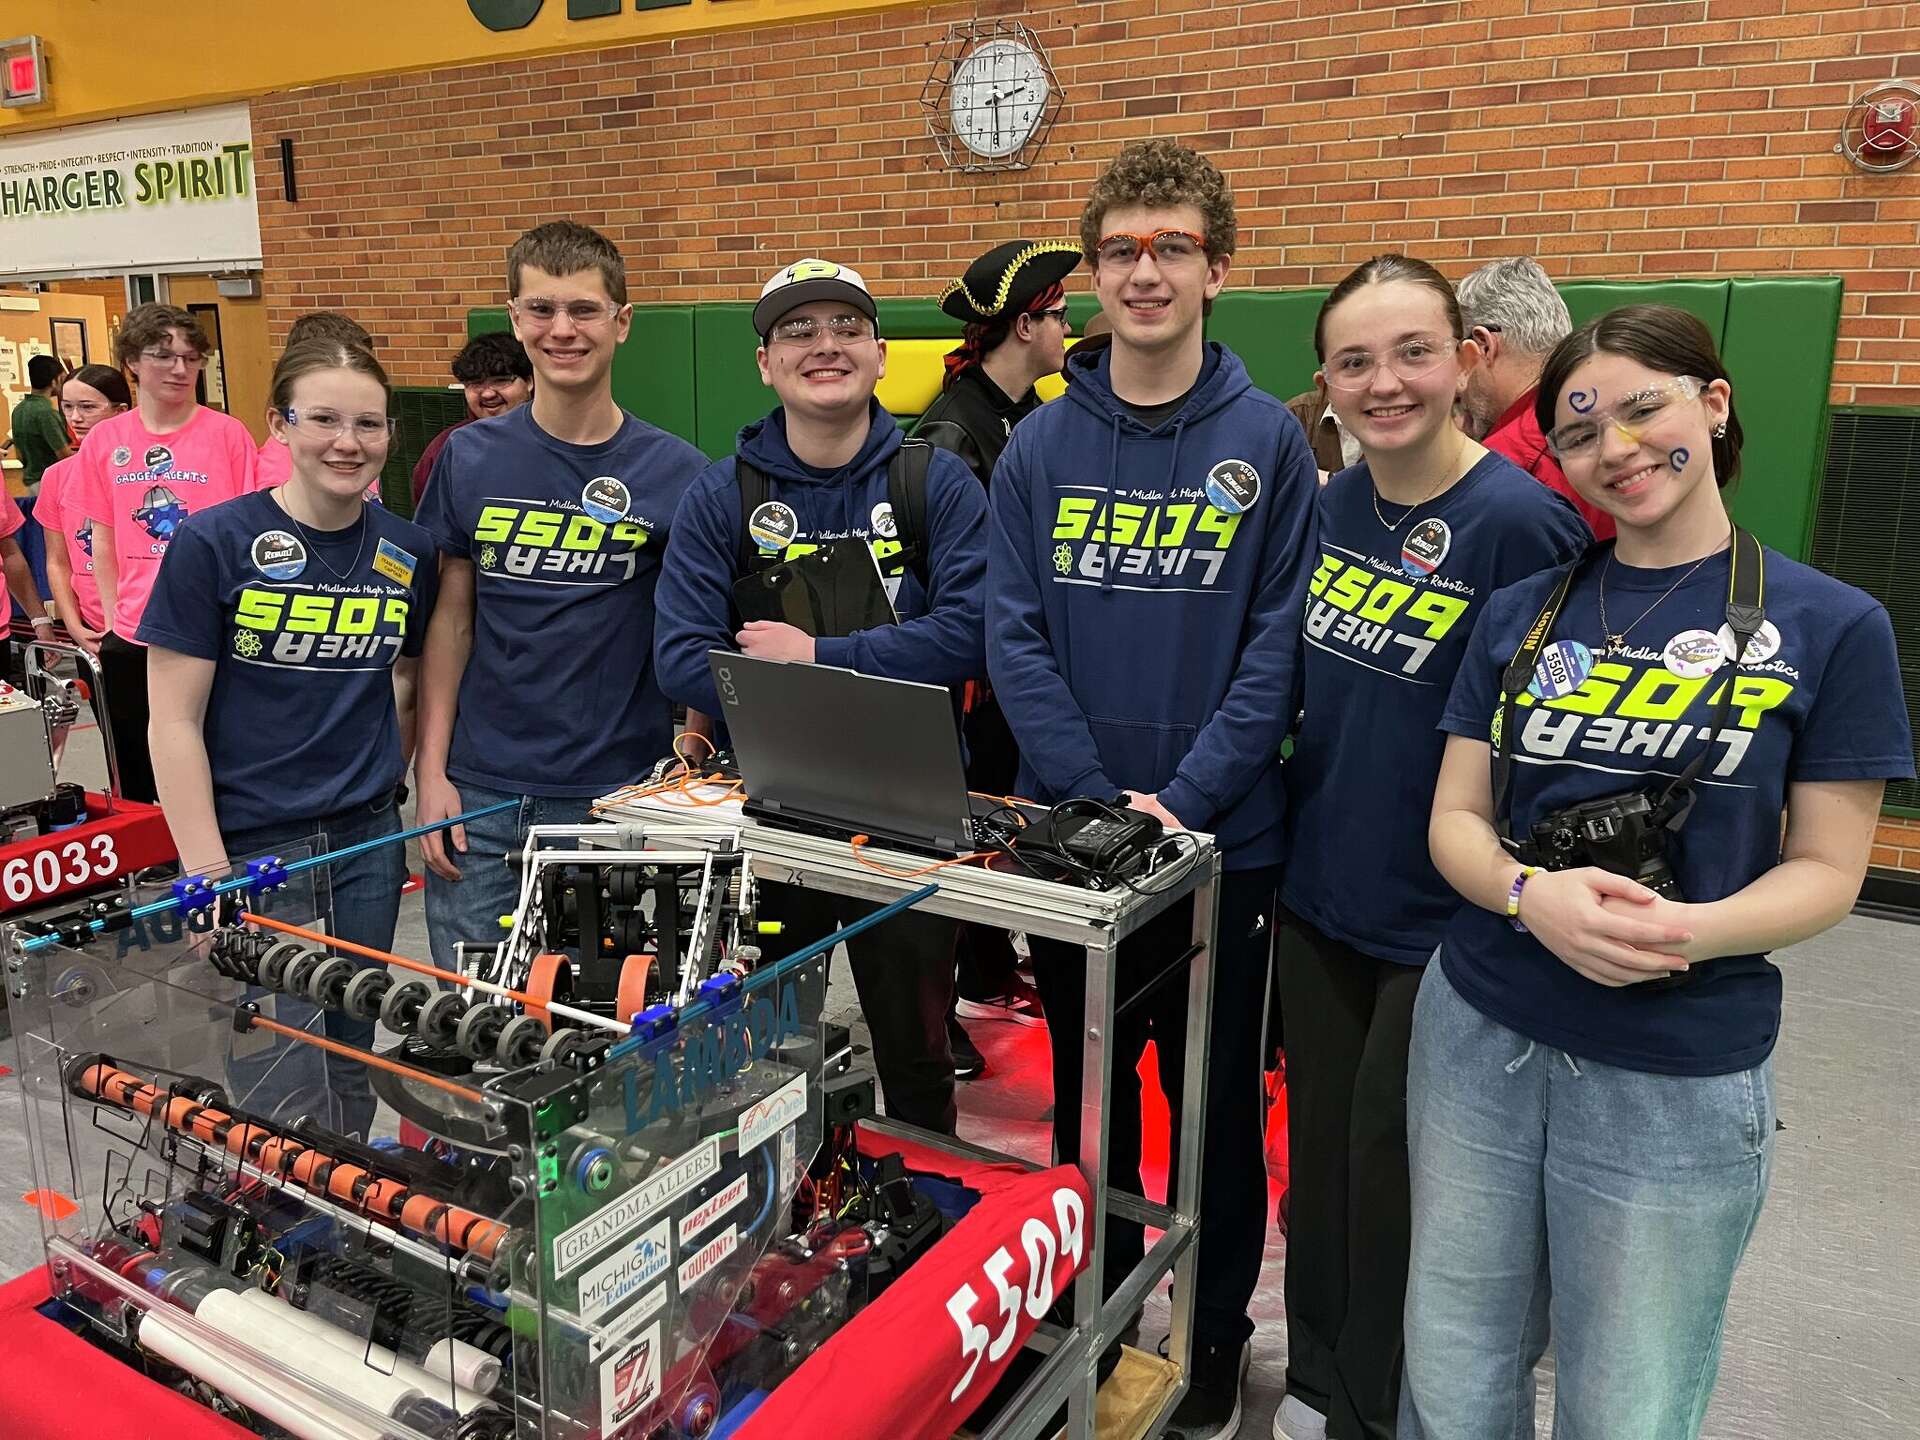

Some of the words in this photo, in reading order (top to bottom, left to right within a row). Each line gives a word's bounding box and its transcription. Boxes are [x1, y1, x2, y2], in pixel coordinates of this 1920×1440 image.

[0, 169, 124, 216] HARGER
[135, 143, 250, 202] SPIRIT
[4, 162, 35, 175] STRENGTH
[39, 160, 58, 171] PRIDE
[61, 156, 94, 168] INTEGRITY
[98, 151, 125, 164] RESPECT
[130, 146, 167, 159] INTENSITY
[172, 141, 213, 155] TRADITION
[163, 471, 208, 484] AGENTS
[1129, 488, 1177, 500] Midlad
[1179, 487, 1205, 502] High
[475, 506, 648, 551] 5509
[549, 499, 585, 513] Midlan
[623, 515, 654, 529] obotics
[852, 528, 870, 540] Hig
[1052, 497, 1242, 549] 5509
[317, 583, 360, 594] Midland
[362, 584, 384, 598] High
[1309, 553, 1470, 640] 5509
[1366, 556, 1404, 577] Midland
[1430, 574, 1475, 596] Robotics
[235, 588, 409, 636] 5509
[1523, 610, 1552, 650] Nikon
[1536, 662, 1549, 687] MEDIA
[1547, 652, 1567, 684] 5509
[1608, 645, 1664, 661] Midla
[1500, 662, 1794, 729] 509
[3, 833, 119, 903] 6033
[624, 981, 801, 1137] LAMBDA
[565, 1189, 650, 1260] GRANDMA
[655, 1150, 711, 1197] ALLERS
[682, 1180, 745, 1236] nexteer
[605, 1251, 668, 1305] Education
[687, 1238, 730, 1281] DUPONT
[946, 1187, 1085, 1402] 5509
